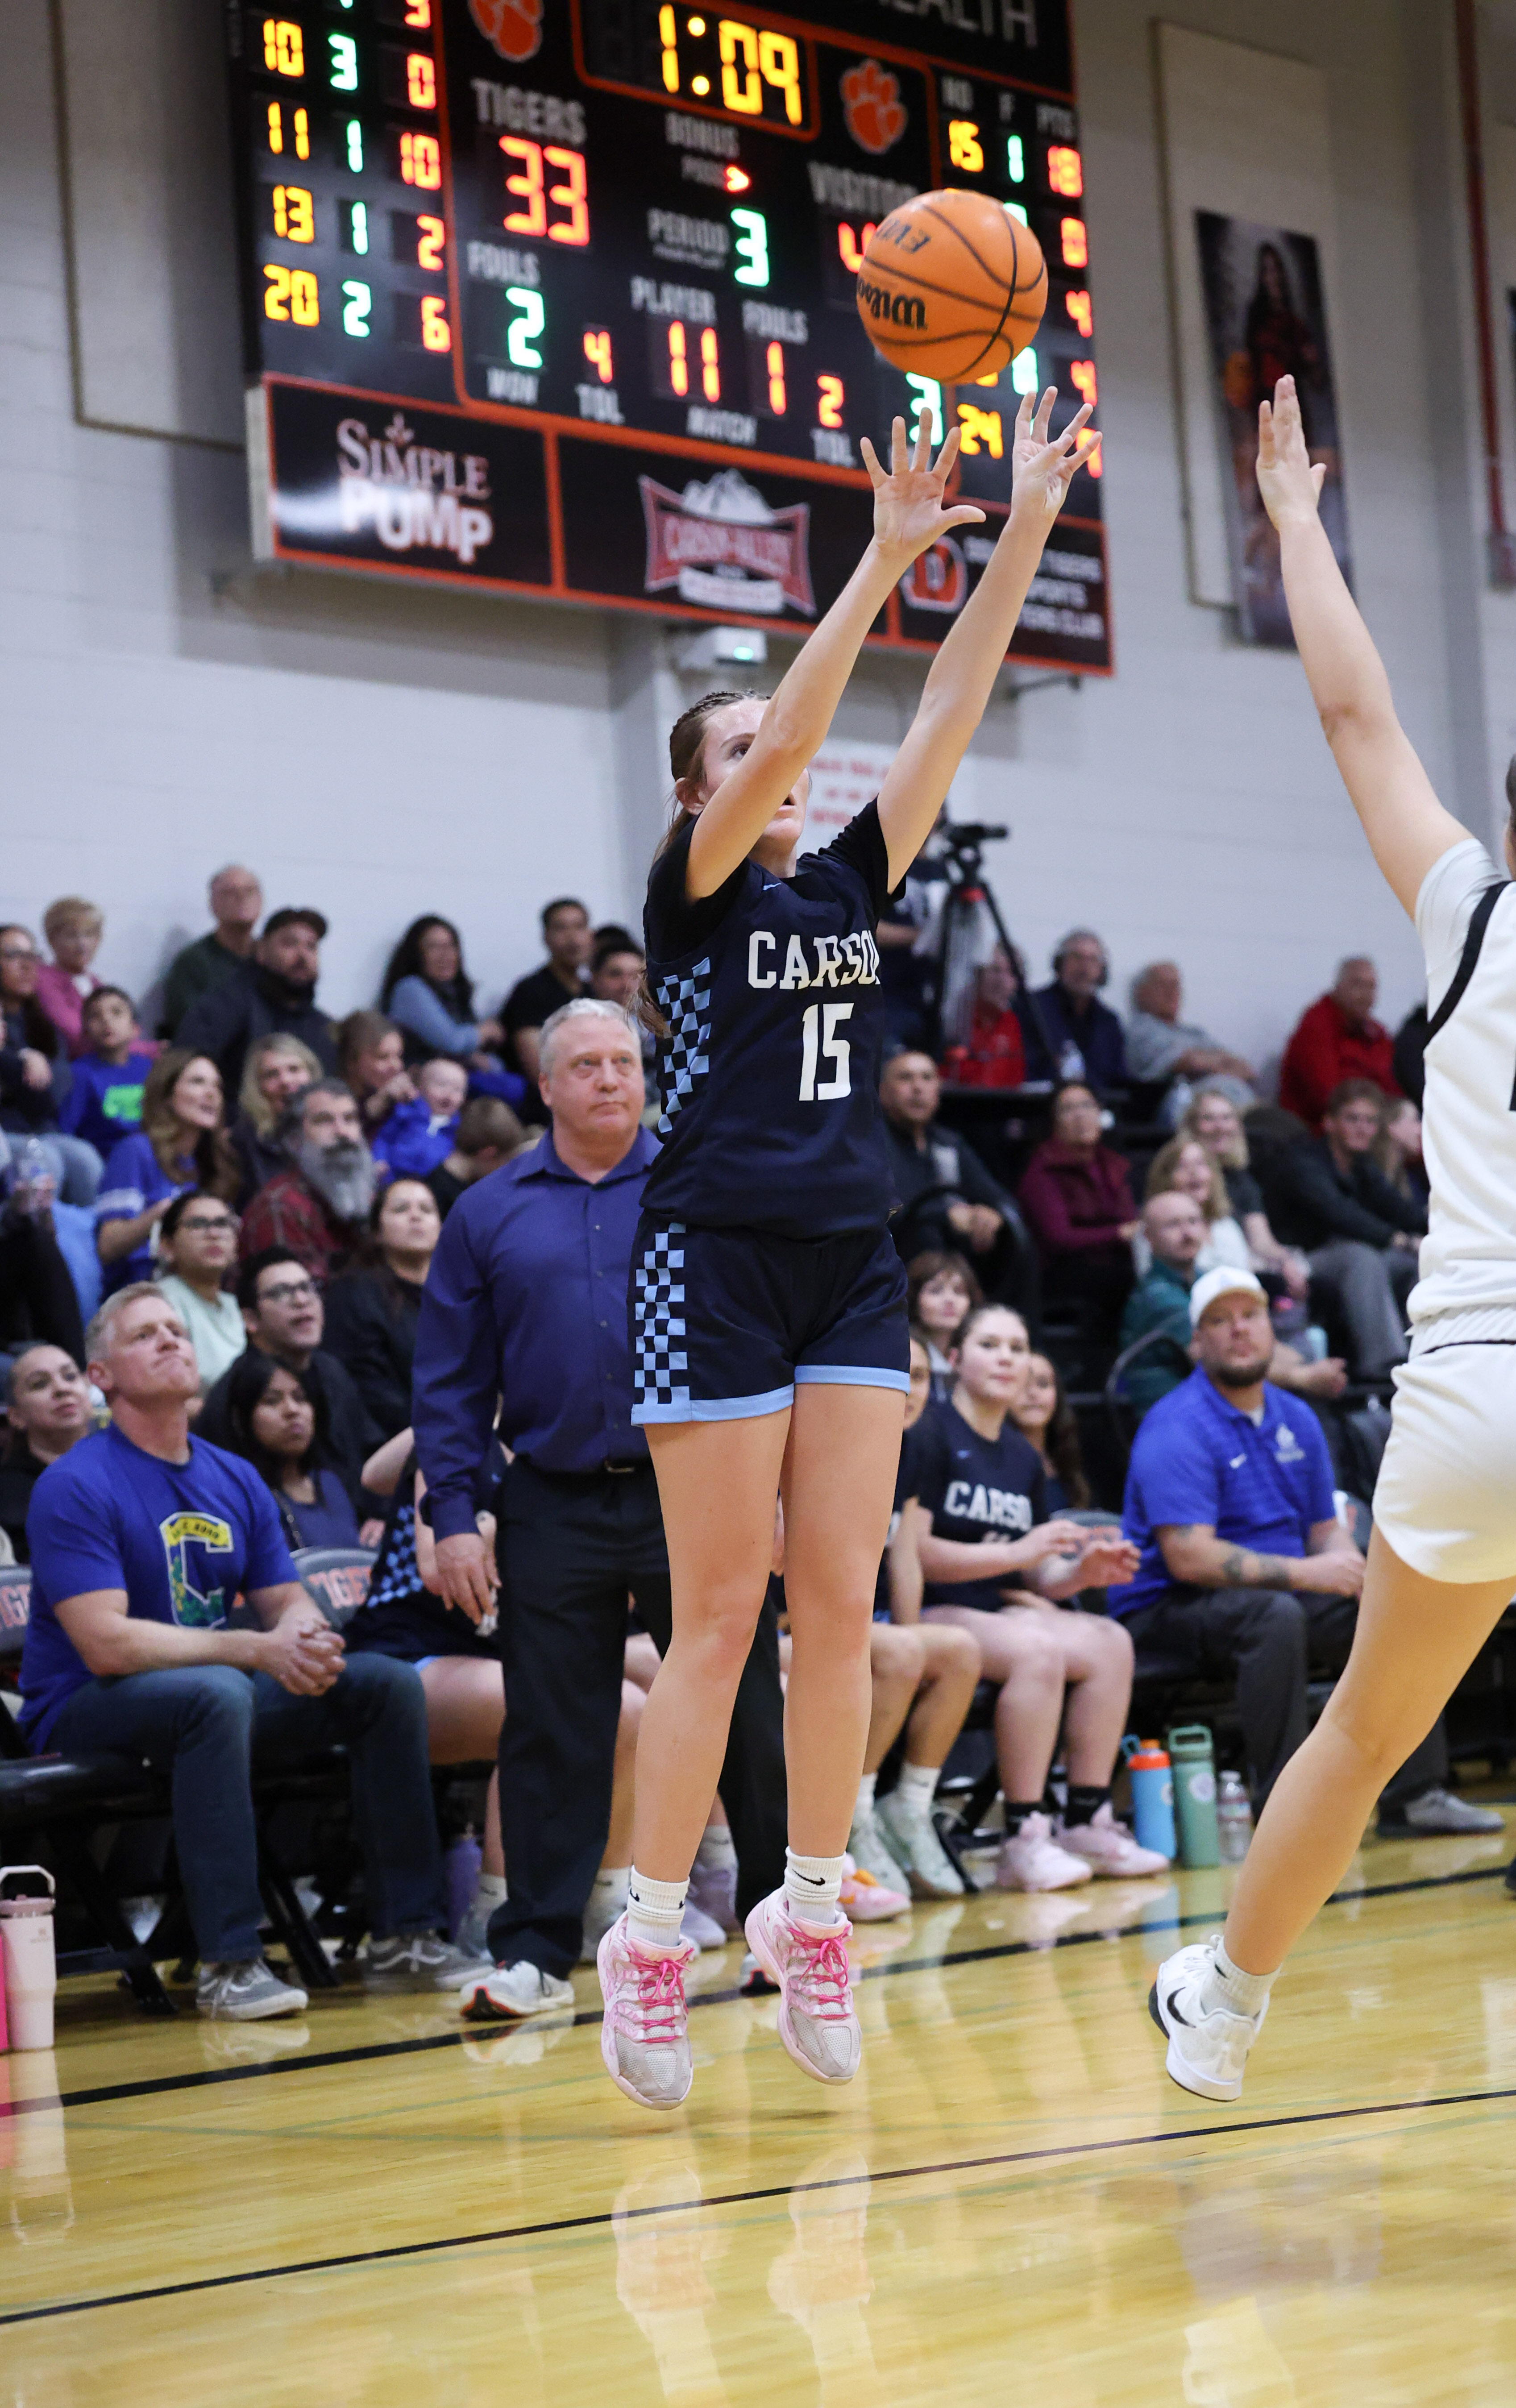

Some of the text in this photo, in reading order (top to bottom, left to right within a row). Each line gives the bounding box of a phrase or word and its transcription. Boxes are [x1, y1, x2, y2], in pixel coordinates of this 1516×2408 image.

[264, 20, 436, 108] 10 3 0
[659, 4, 802, 126] 1:09
[268, 103, 441, 190] 11 1 10
[471, 79, 586, 146] TIGERS
[949, 120, 984, 172] 15
[1007, 135, 1024, 183] 1
[273, 186, 445, 271] 13 1 2
[499, 135, 590, 246] 33
[648, 207, 730, 254] PERIOD
[467, 240, 540, 285] FOULS
[731, 208, 769, 286] 3
[264, 264, 451, 353] 20 2 6
[506, 287, 545, 369] 2
[630, 276, 808, 343] PLAYER FOULS
[857, 278, 929, 331] Wilso
[583, 331, 613, 383] 4
[668, 321, 787, 415] 11 1
[817, 374, 844, 428] 2
[906, 372, 944, 446] 3
[957, 404, 1003, 459] 24
[336, 418, 491, 500] SIMPLE
[340, 475, 493, 565] PUMP
[798, 1002, 854, 1101] 15
